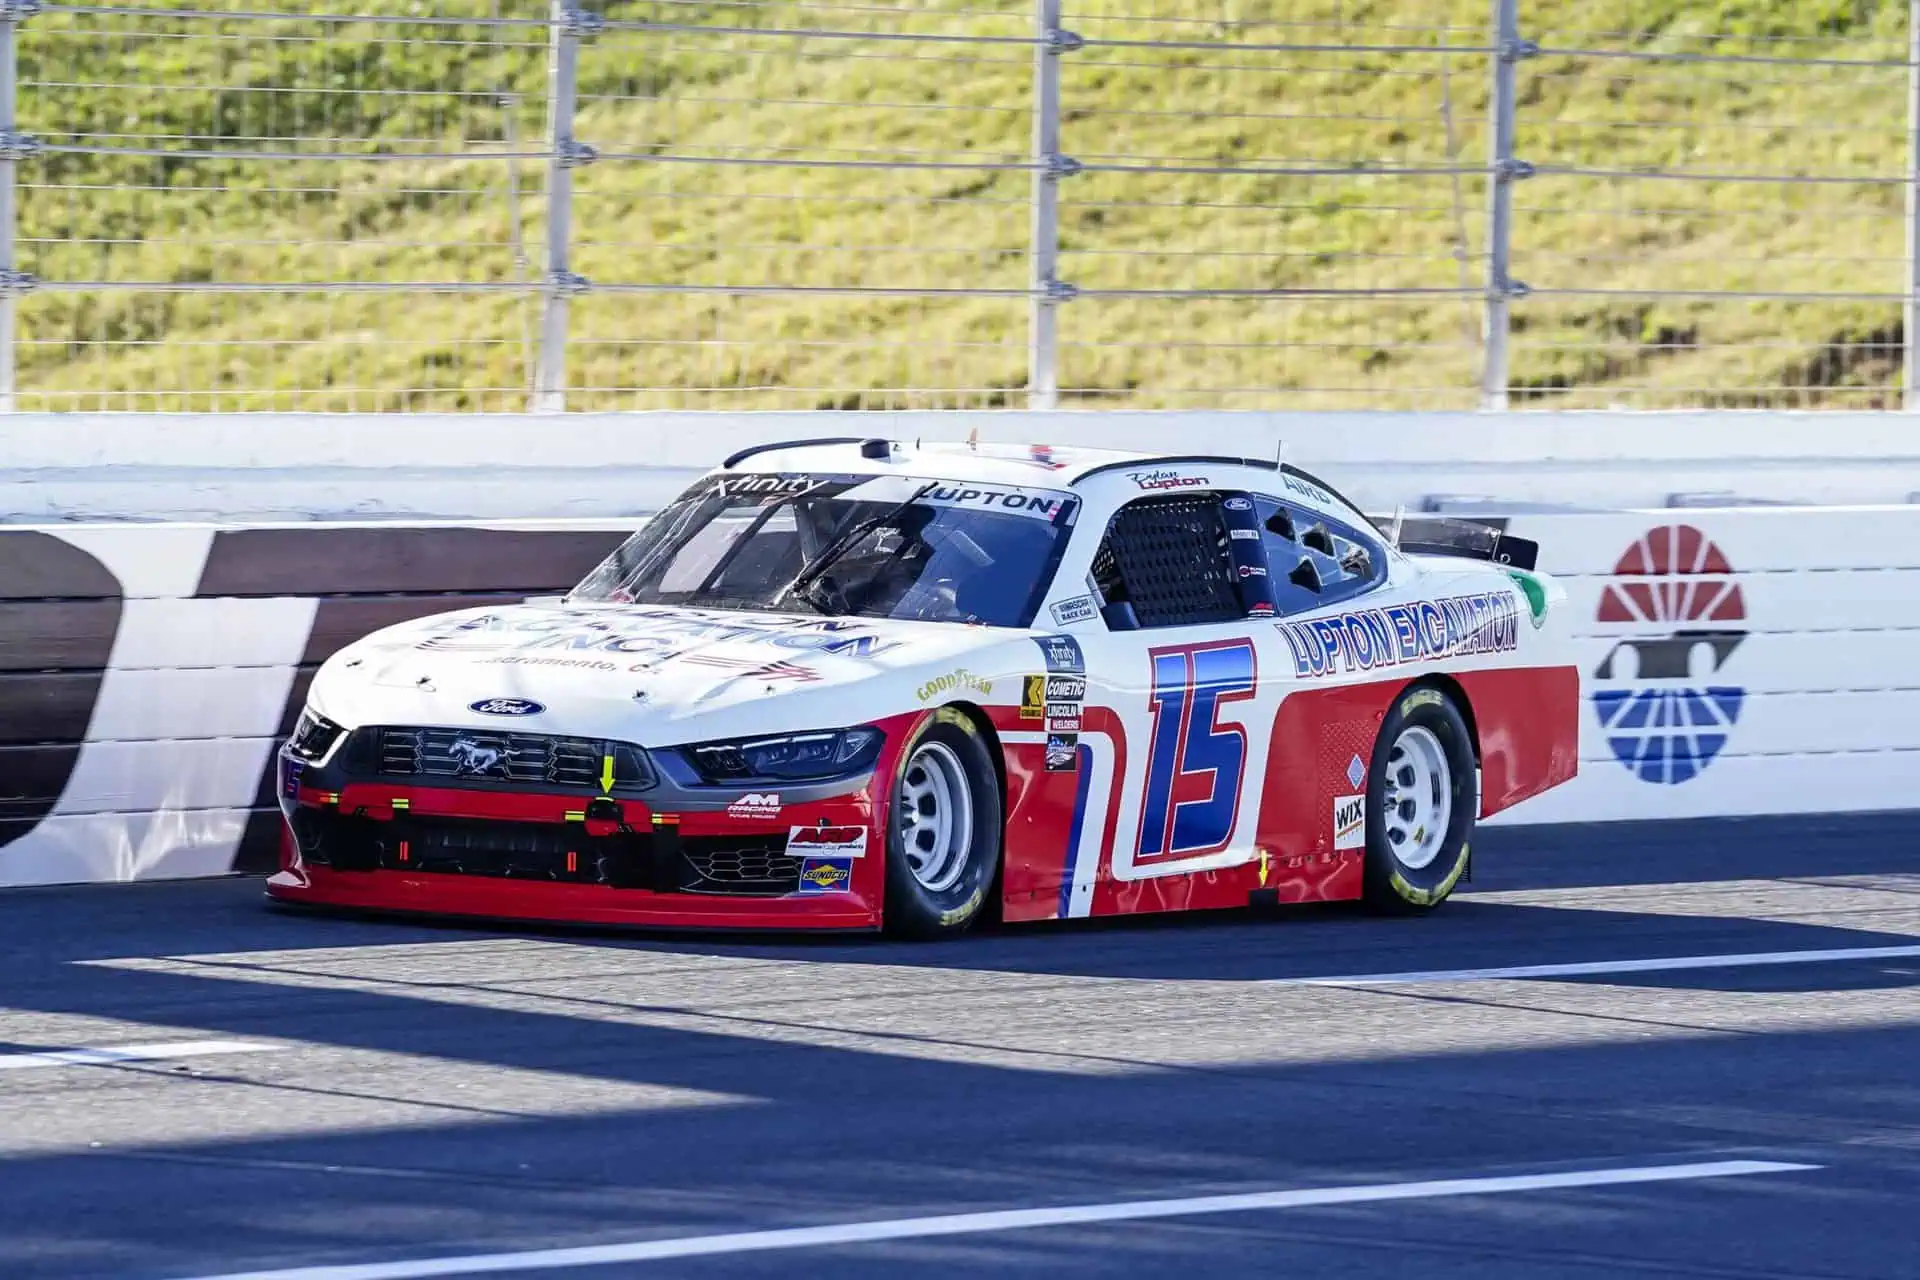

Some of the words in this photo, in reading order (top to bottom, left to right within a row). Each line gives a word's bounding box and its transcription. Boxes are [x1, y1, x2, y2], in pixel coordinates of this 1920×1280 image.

[1137, 474, 1210, 491] Lupton
[912, 486, 1052, 514] LUPTON
[1273, 609, 1396, 678] LUPTON
[1382, 590, 1519, 664] EXCAVATION
[1047, 680, 1085, 697] COMETIC
[1047, 704, 1077, 717] LINCOLN
[1132, 637, 1258, 867] 15
[1336, 797, 1363, 830] WIX
[803, 870, 848, 881] SUNOCO
